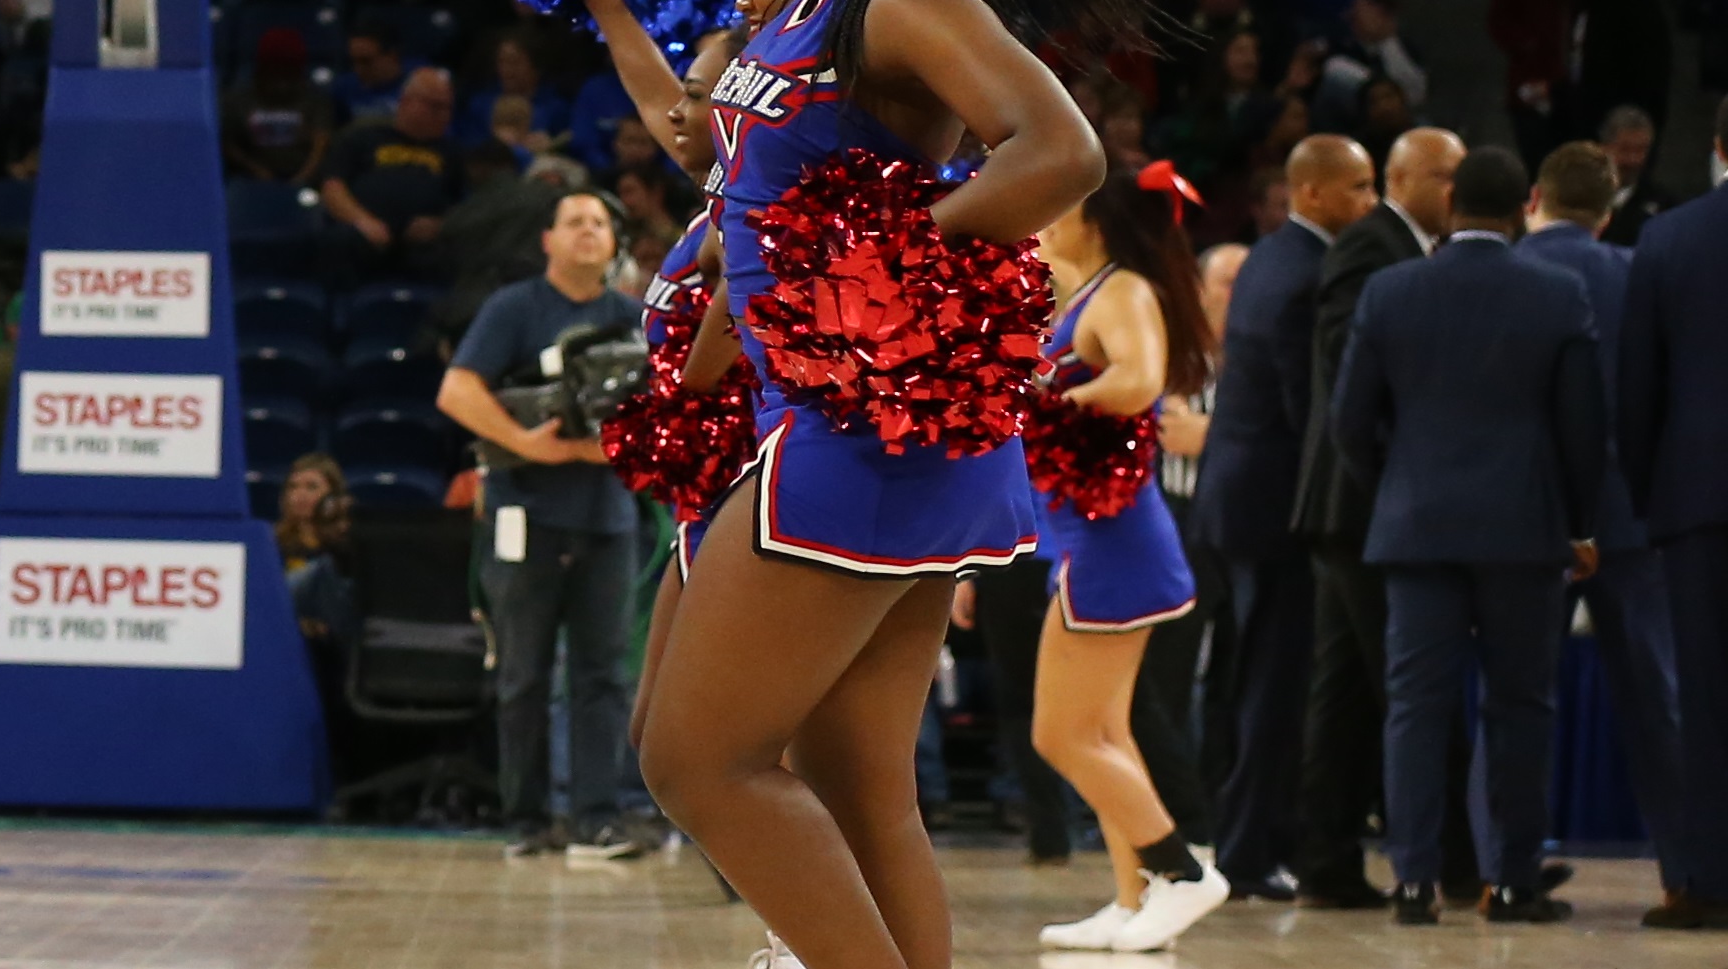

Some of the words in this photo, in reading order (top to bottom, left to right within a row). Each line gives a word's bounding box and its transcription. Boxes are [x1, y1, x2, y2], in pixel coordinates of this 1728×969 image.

[54, 268, 193, 298] STAPLES
[34, 392, 203, 430] STAPLES
[11, 563, 221, 609] STAPLES
[9, 615, 54, 640] IT'S
[61, 617, 107, 641] PRO
